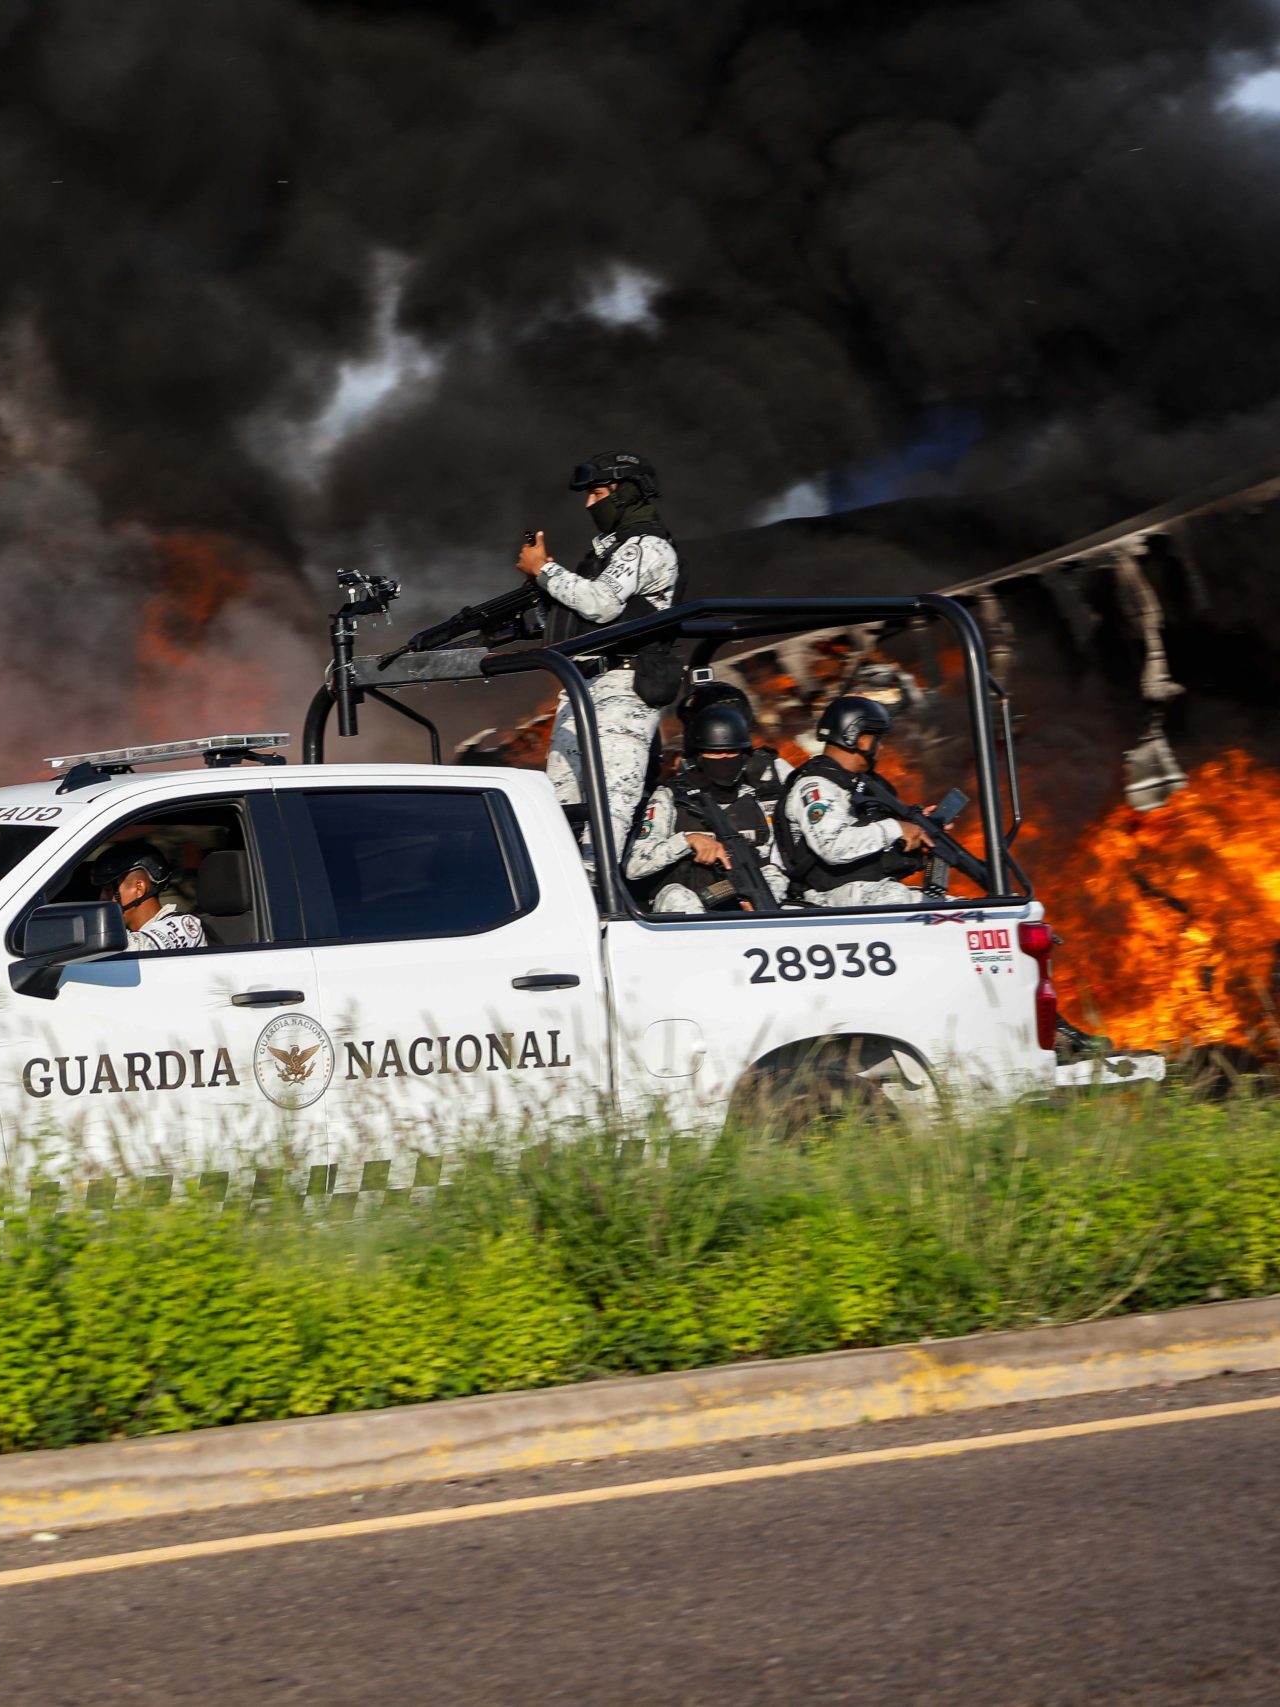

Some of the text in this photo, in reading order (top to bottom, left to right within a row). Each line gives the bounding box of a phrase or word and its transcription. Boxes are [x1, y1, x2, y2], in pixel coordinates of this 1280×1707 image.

[969, 931, 1009, 949] 911
[743, 941, 897, 984] 28938
[259, 1018, 328, 1055] GUARDIA NACIONAL
[22, 1029, 571, 1098] GUARDIA NACIONAL
